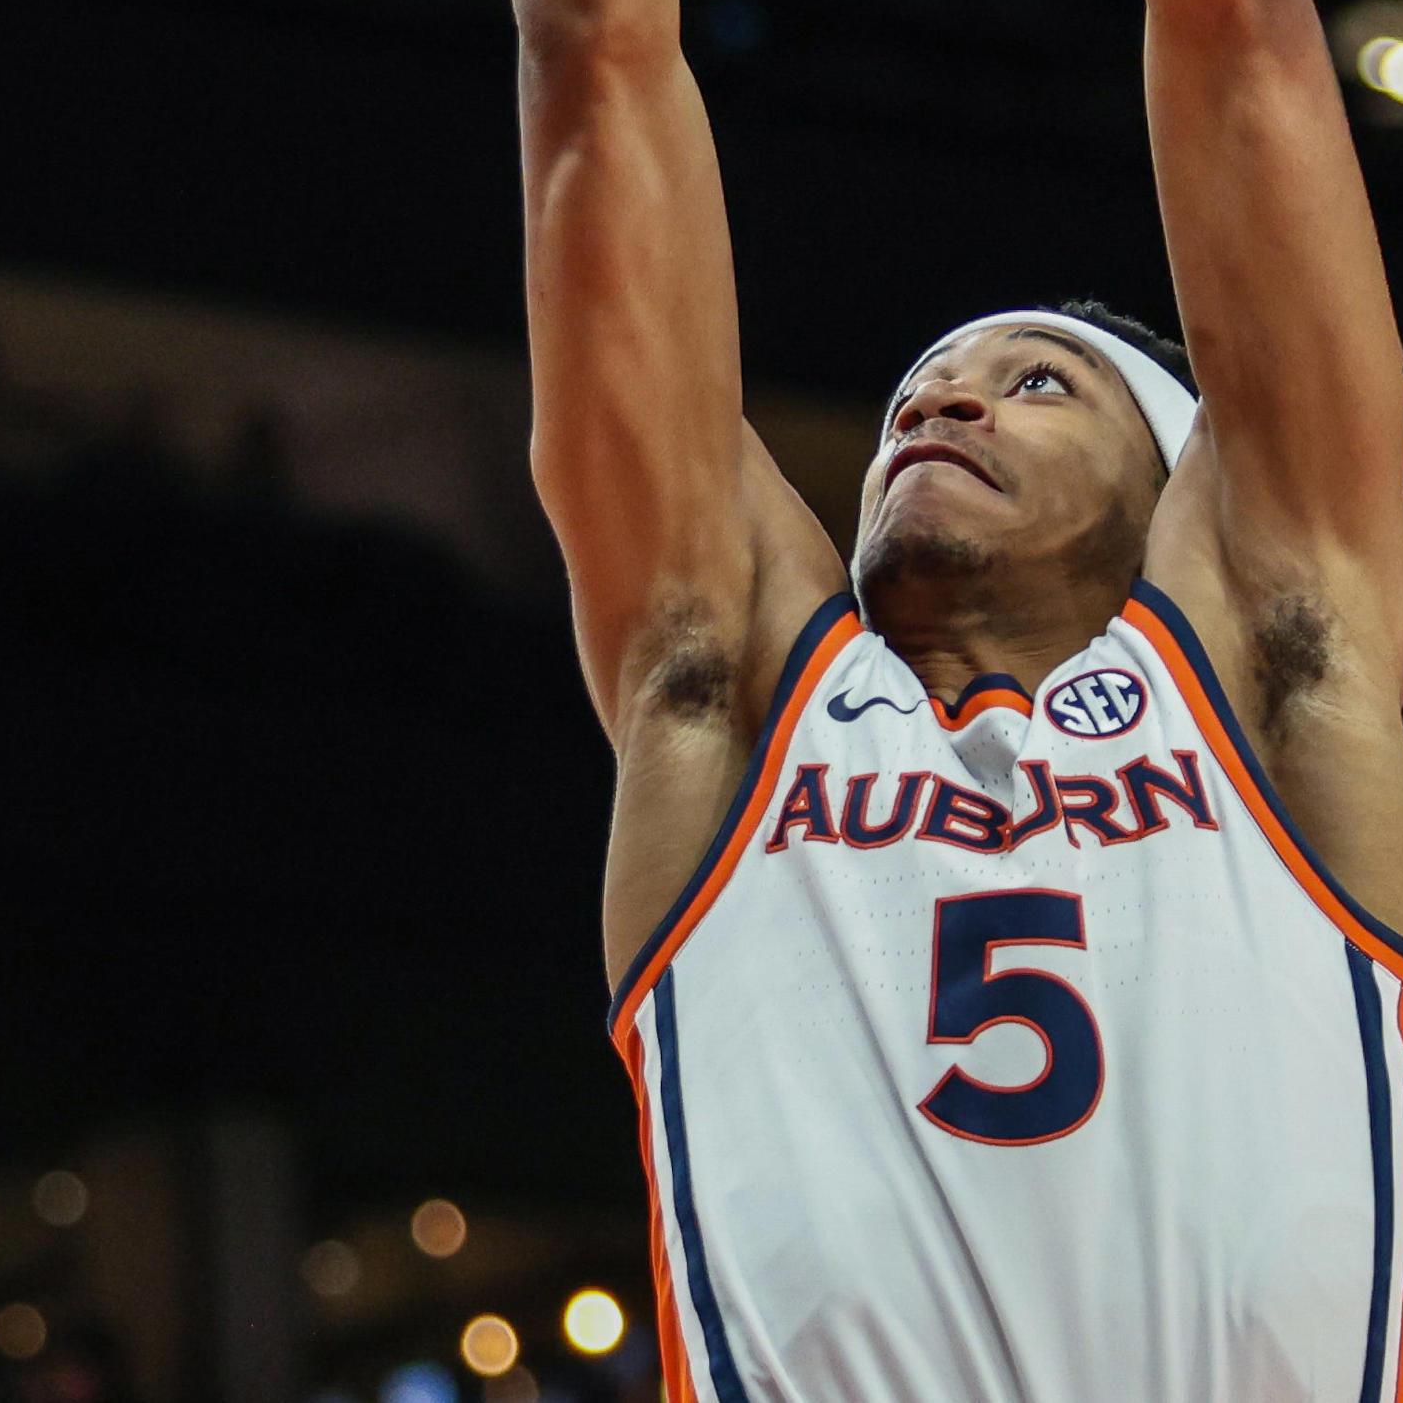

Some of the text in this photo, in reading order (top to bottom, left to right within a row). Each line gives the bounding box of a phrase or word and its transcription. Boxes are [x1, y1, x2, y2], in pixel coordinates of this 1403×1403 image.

[1048, 671, 1142, 735] SEC
[766, 749, 1220, 856] AUBURN
[916, 887, 1106, 1147] 5
